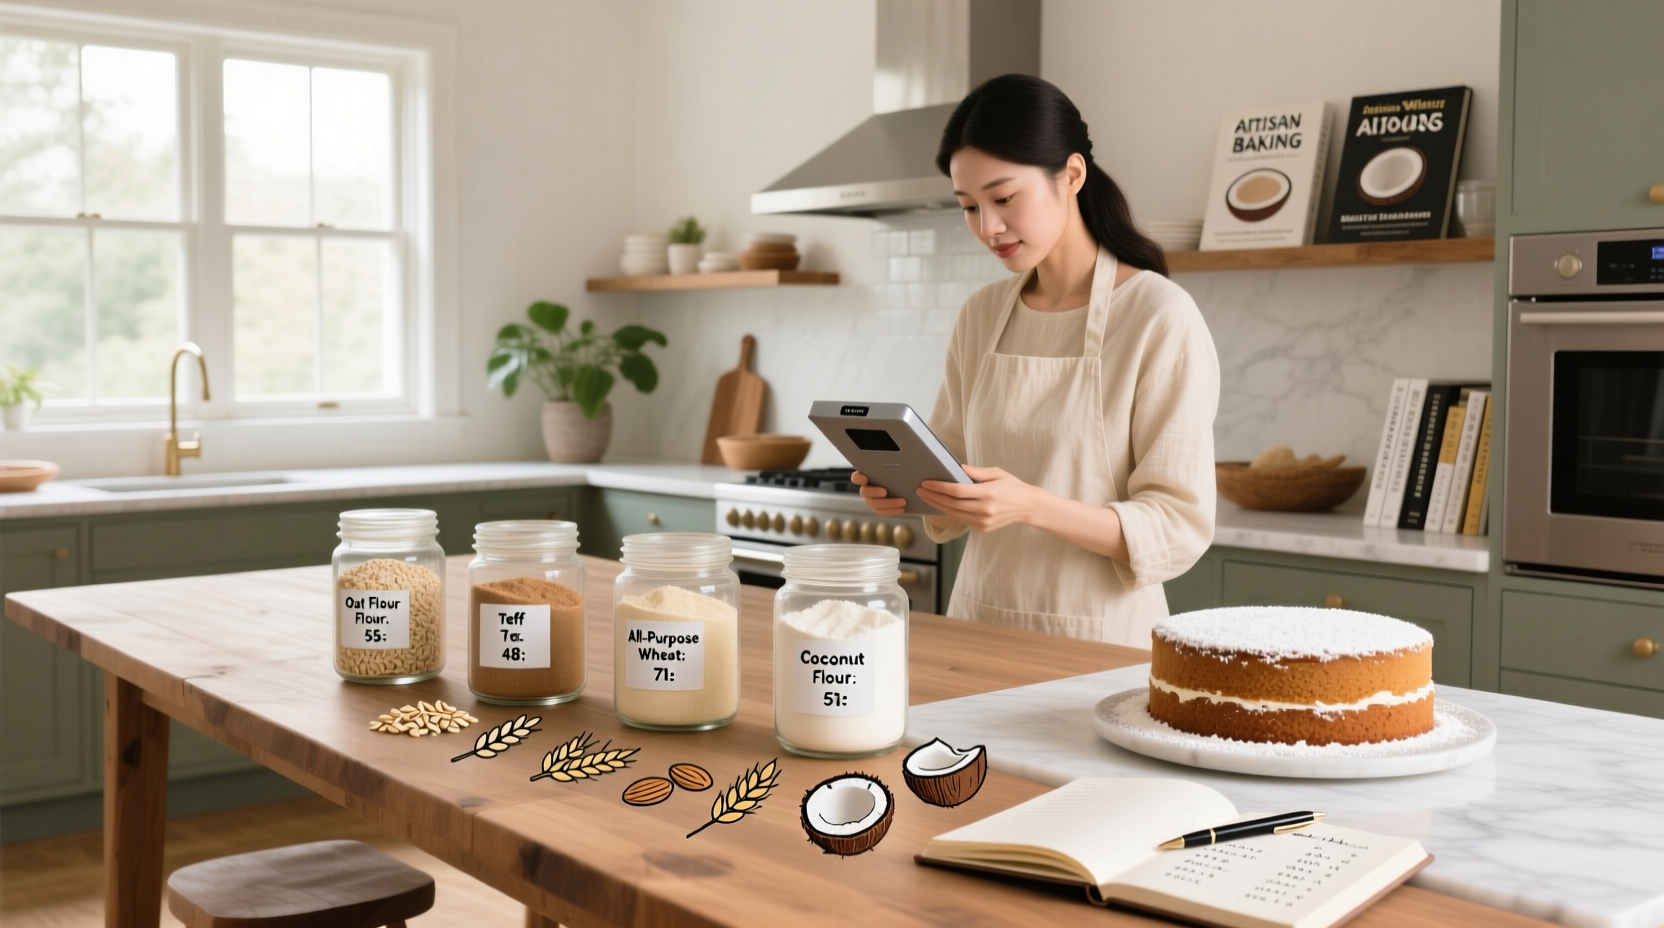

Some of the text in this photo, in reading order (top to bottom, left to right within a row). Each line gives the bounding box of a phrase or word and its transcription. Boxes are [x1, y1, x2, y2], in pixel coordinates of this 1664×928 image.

[1232, 132, 1302, 153] BAKING
[345, 596, 401, 609] Oat Flour
[498, 612, 526, 626] Teff
[628, 629, 699, 648] All-Purpose
[638, 648, 686, 661] Wheat:
[800, 650, 865, 666] Coconut
[812, 669, 856, 685] Flour:
